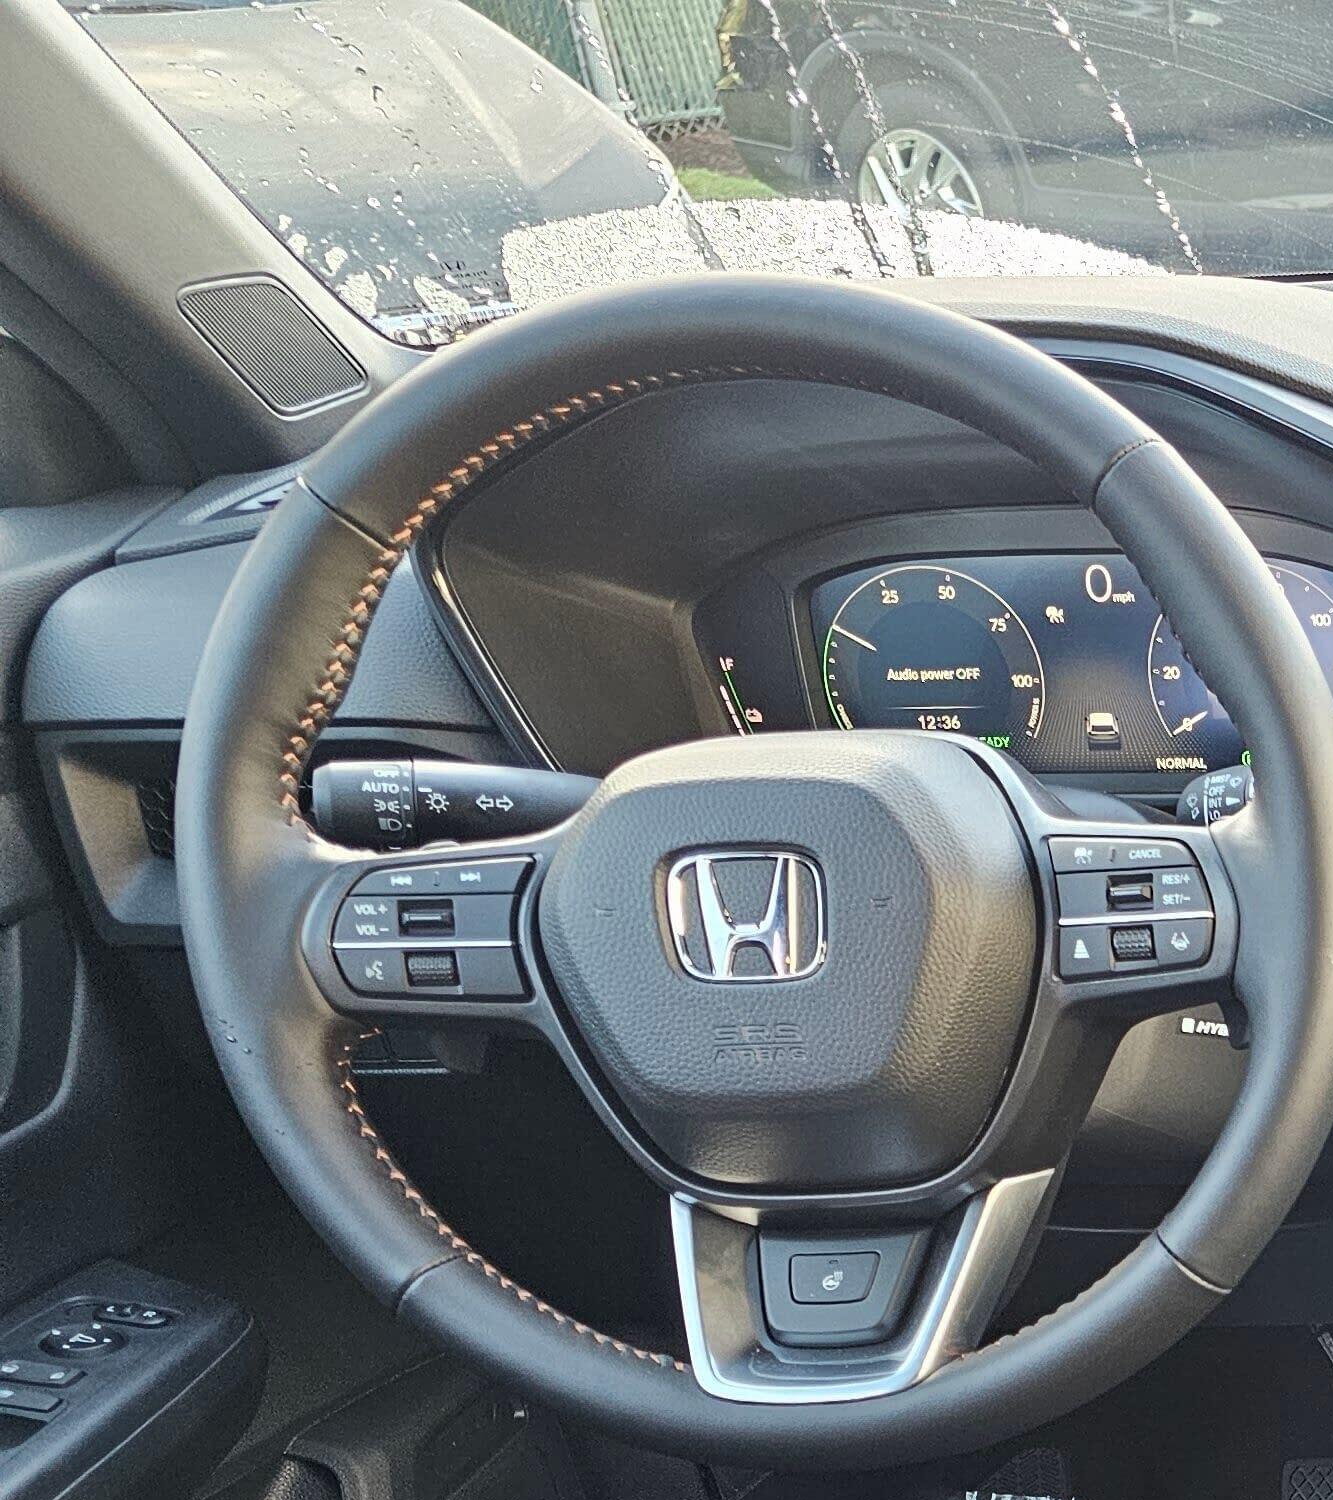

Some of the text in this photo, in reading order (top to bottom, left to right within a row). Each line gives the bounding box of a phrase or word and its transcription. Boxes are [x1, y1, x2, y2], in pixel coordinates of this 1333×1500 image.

[1085, 564, 1136, 604] 0 mph
[881, 590, 899, 604] 25
[938, 585, 956, 600] 50
[988, 618, 1007, 632] 75
[1310, 613, 1331, 627] 100
[886, 667, 981, 683] Audio power OFF
[1162, 665, 1181, 680] 20
[1011, 674, 1034, 688] 100
[917, 715, 961, 730] 12:36
[1155, 757, 1208, 770] NORMAL
[361, 781, 400, 794] AUTO
[1208, 785, 1227, 797] OFF
[1208, 796, 1222, 809] INT
[1128, 848, 1163, 860] CANCEL
